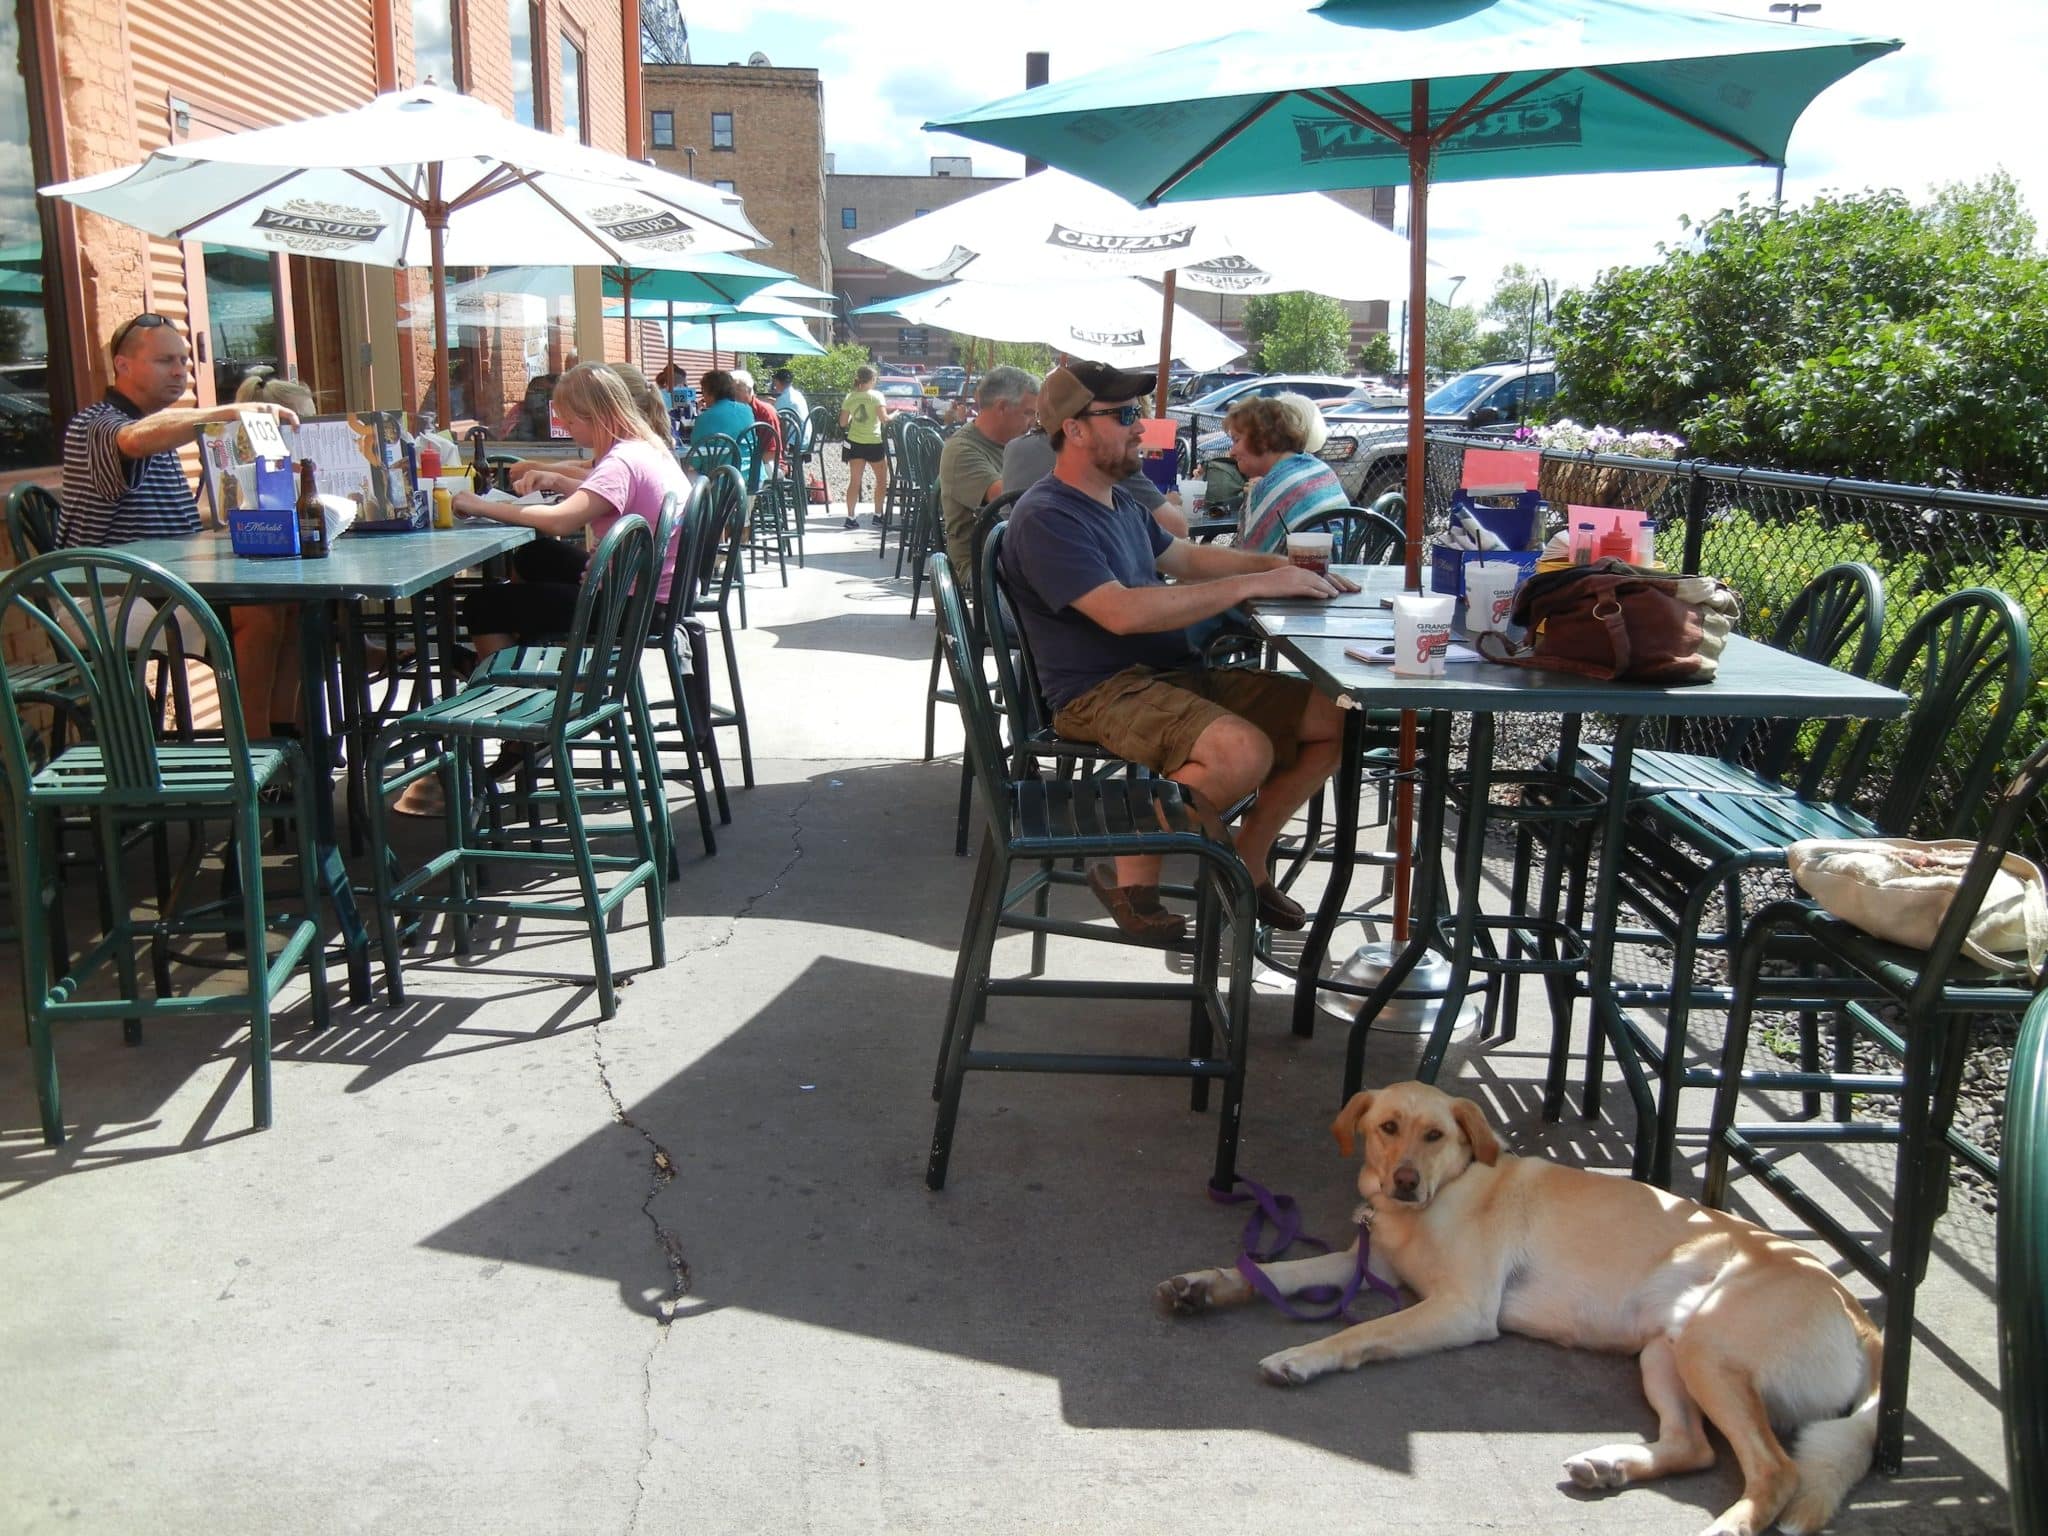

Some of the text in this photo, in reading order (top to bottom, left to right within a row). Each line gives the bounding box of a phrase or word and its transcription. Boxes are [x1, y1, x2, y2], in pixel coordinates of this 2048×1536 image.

[1057, 227, 1190, 249] CRUZAN
[1072, 328, 1141, 344] CRUZAN
[247, 420, 278, 441] 103
